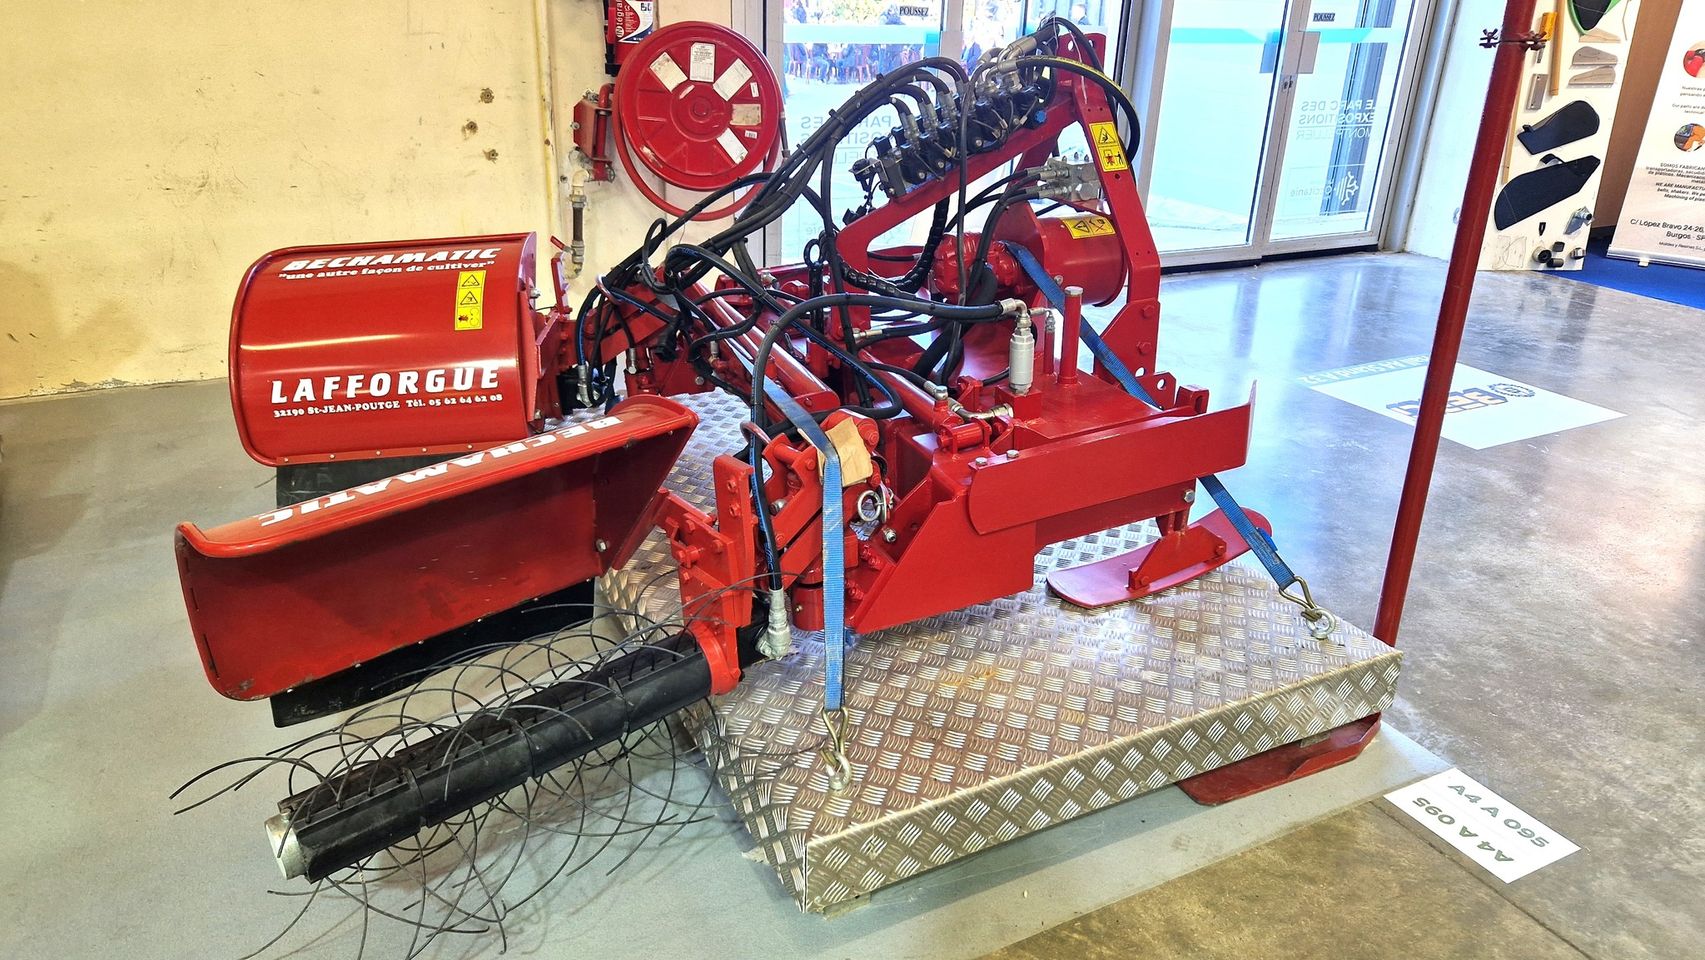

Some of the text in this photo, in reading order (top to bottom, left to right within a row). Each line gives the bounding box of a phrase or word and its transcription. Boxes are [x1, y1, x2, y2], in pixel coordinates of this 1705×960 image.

[899, 6, 929, 17] POUSSEZ
[1662, 222, 1683, 230] Bravo
[1666, 230, 1691, 239] Burgos
[281, 247, 502, 271] BECHAMATIC
[316, 269, 359, 278] autre
[361, 265, 404, 277] façon
[406, 264, 424, 273] de
[271, 365, 500, 404] LAFFORGUE
[273, 407, 305, 418] 32190
[307, 400, 401, 416] St-JEAN-POUTGE
[429, 397, 443, 407] 05
[444, 395, 458, 405] 62
[460, 394, 473, 404] 64
[474, 394, 488, 403] 62
[490, 393, 503, 402] 08
[258, 416, 622, 527] BECHAMATIC
[1447, 783, 1550, 848] A4 A 095
[1412, 796, 1514, 862] A4 A 095
